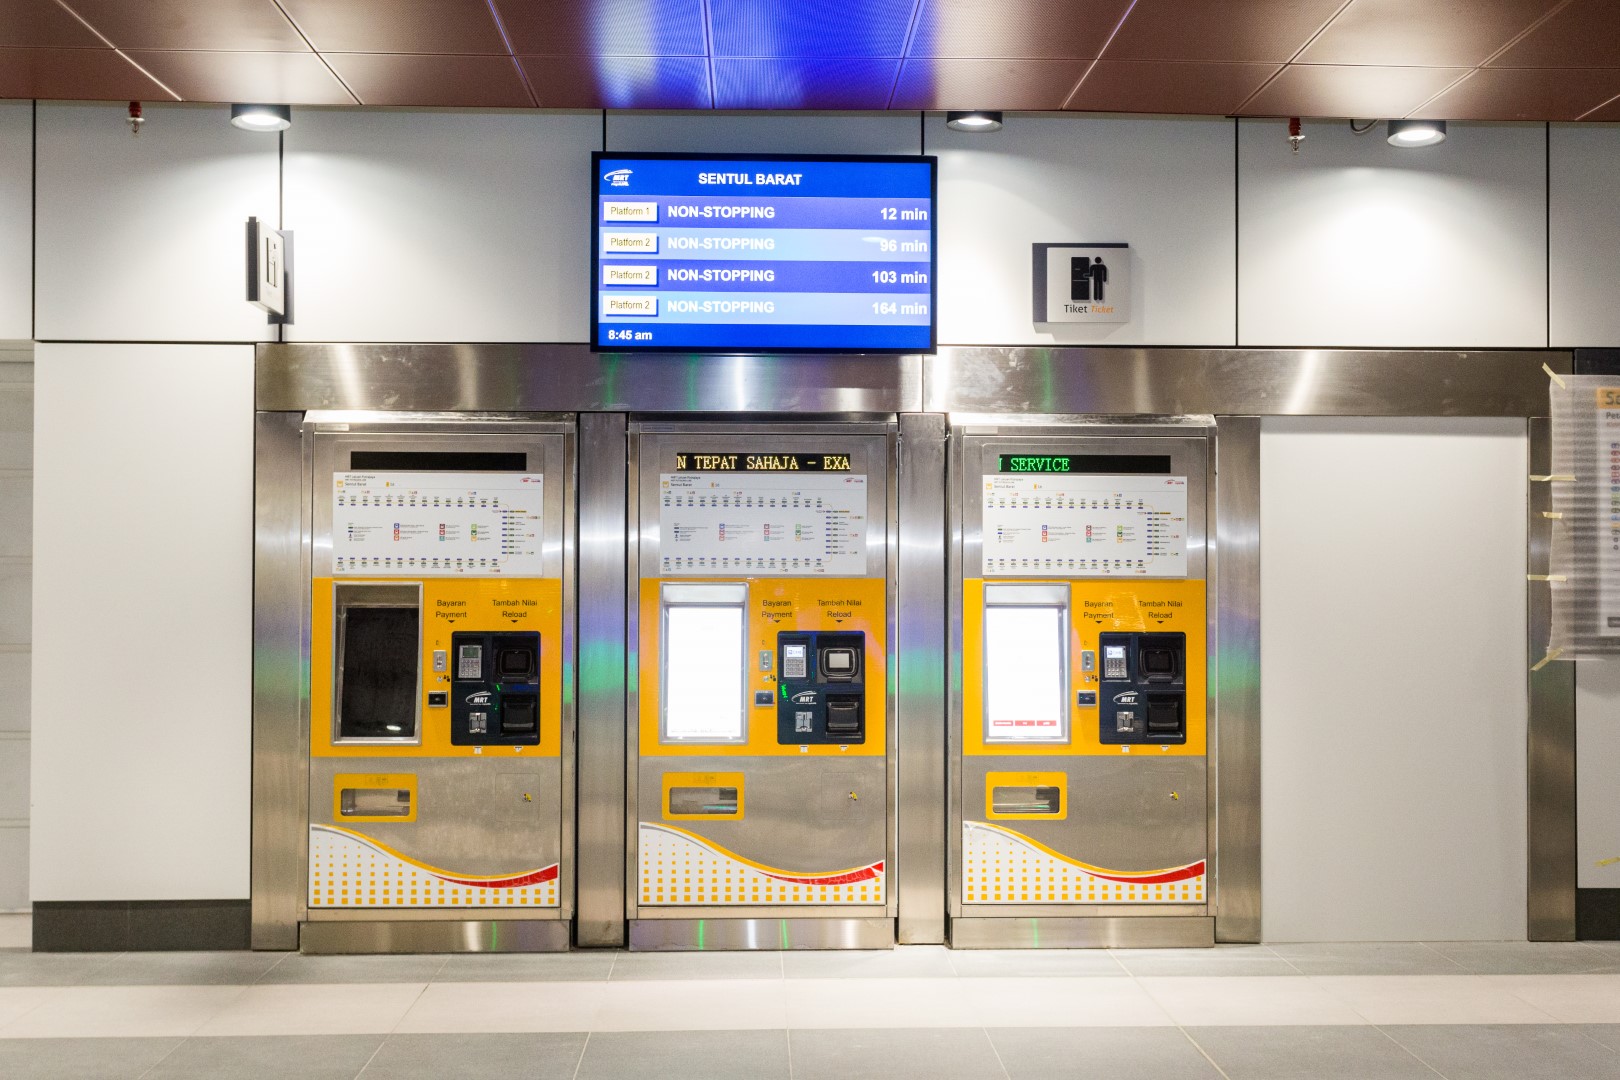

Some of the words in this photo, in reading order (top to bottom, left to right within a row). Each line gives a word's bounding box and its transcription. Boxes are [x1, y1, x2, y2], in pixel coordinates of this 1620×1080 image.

[698, 173, 753, 185] SENTUL
[755, 173, 803, 186] BARAT
[610, 207, 644, 216] Platform
[645, 207, 651, 216] 1
[667, 205, 776, 219] NON-STOPPING
[881, 207, 898, 221] 12
[900, 207, 928, 221] min
[610, 237, 644, 247] Platform
[645, 237, 651, 247] 2
[667, 237, 776, 250] NON-STOPPING
[880, 239, 898, 252] 96
[900, 239, 928, 252] min
[610, 270, 644, 280] Platform
[645, 270, 651, 280] 2
[667, 269, 776, 282] NON-STOPPING
[872, 271, 898, 284] 103
[900, 271, 928, 284] min
[610, 300, 644, 310] Platform
[645, 300, 651, 310] 2
[667, 300, 776, 314] NON-STOPPING
[872, 302, 898, 315] 164
[900, 302, 928, 315] min
[1064, 304, 1088, 314] Tiket
[1091, 304, 1115, 314] Ticket
[608, 330, 633, 341] 8:45
[634, 331, 653, 341] am
[694, 455, 738, 470] TEPAT
[746, 456, 799, 470] SAHAJA
[823, 456, 850, 470] EXA
[1010, 457, 1070, 472] SERVICE
[436, 600, 467, 608] Bayaran
[762, 600, 792, 608] Bayaran
[1084, 600, 1114, 608] Bayaran
[435, 611, 468, 619] Payment
[761, 611, 793, 619] Payment
[1083, 612, 1114, 620] Payment
[473, 696, 488, 704] MRT
